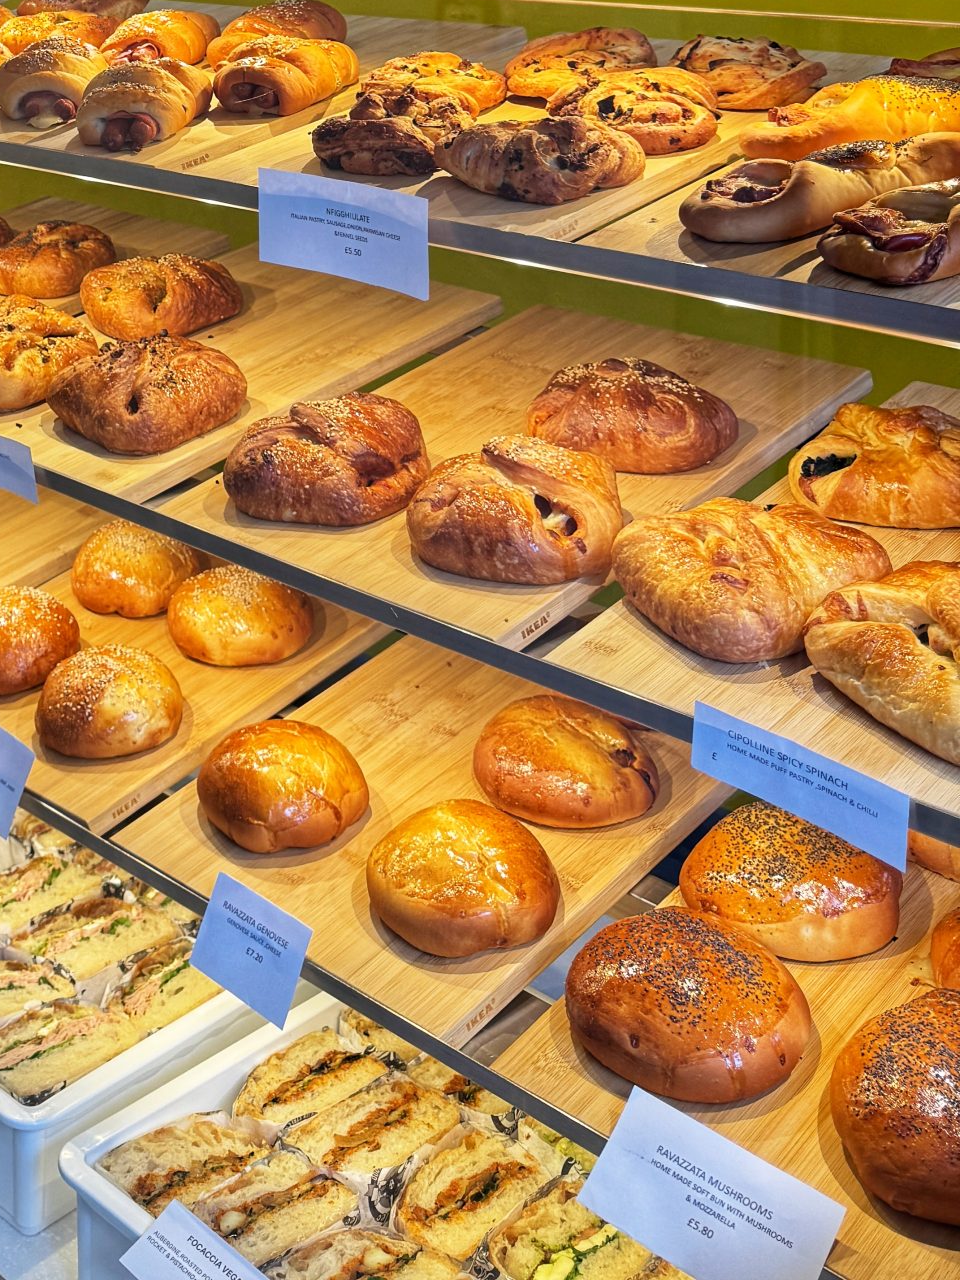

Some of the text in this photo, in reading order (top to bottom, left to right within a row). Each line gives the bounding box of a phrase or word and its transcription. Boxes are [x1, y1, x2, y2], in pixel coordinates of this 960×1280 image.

[520, 616, 549, 640] IKEA
[712, 752, 718, 761] £
[728, 729, 848, 791] CIPOLLINE SPICY SPINACH
[727, 742, 748, 757] HOME
[749, 753, 770, 767] MADE
[771, 762, 788, 776] PUFF
[789, 771, 814, 788] PASTRY
[849, 798, 855, 807] &
[856, 801, 879, 819] CHILLI
[223, 900, 289, 950] RAVAZZATA GENOVESE
[245, 947, 264, 964] £7.20
[466, 1003, 493, 1032] IKEA
[656, 1145, 774, 1221] RAVAZZATA MUSHROOMS
[650, 1158, 794, 1249] HOME MADE SOFT BUN WITH MUSHROOMS
[685, 1194, 736, 1230] & MOZZARELLA
[147, 1236, 167, 1254] ROCKET
[687, 1218, 715, 1239] £5.80
[187, 1235, 242, 1280] FOCACCIA VEG
